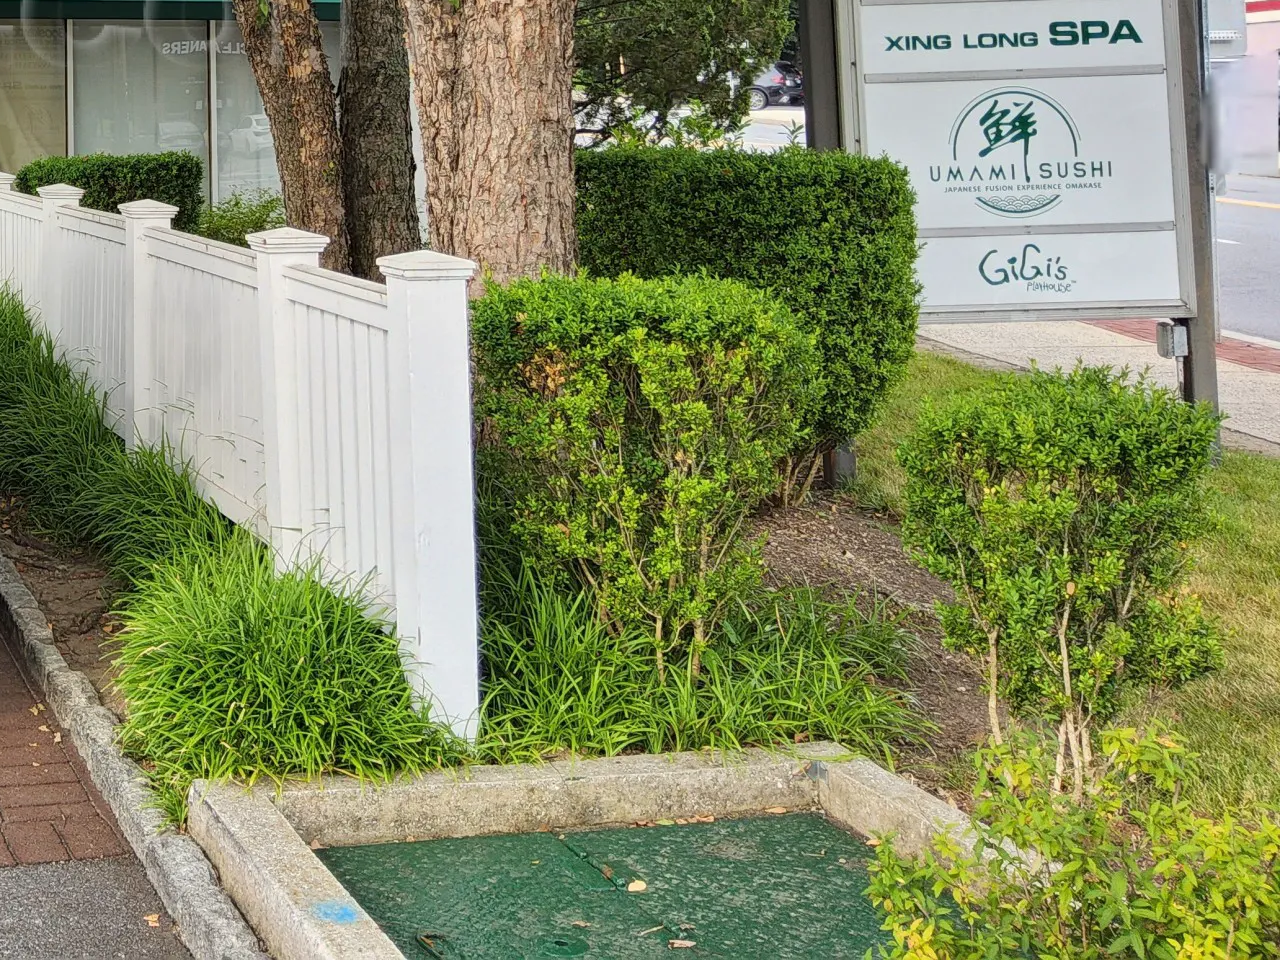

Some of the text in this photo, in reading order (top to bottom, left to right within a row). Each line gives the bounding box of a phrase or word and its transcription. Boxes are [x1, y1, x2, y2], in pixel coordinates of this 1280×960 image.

[884, 19, 1144, 52] XING LONG SPA
[929, 160, 1113, 182] UMAMI SUSHI
[944, 182, 1102, 193] JAPANESE FUSION EXPERIENCE OMAKASE
[978, 243, 1069, 286] GiGi's
